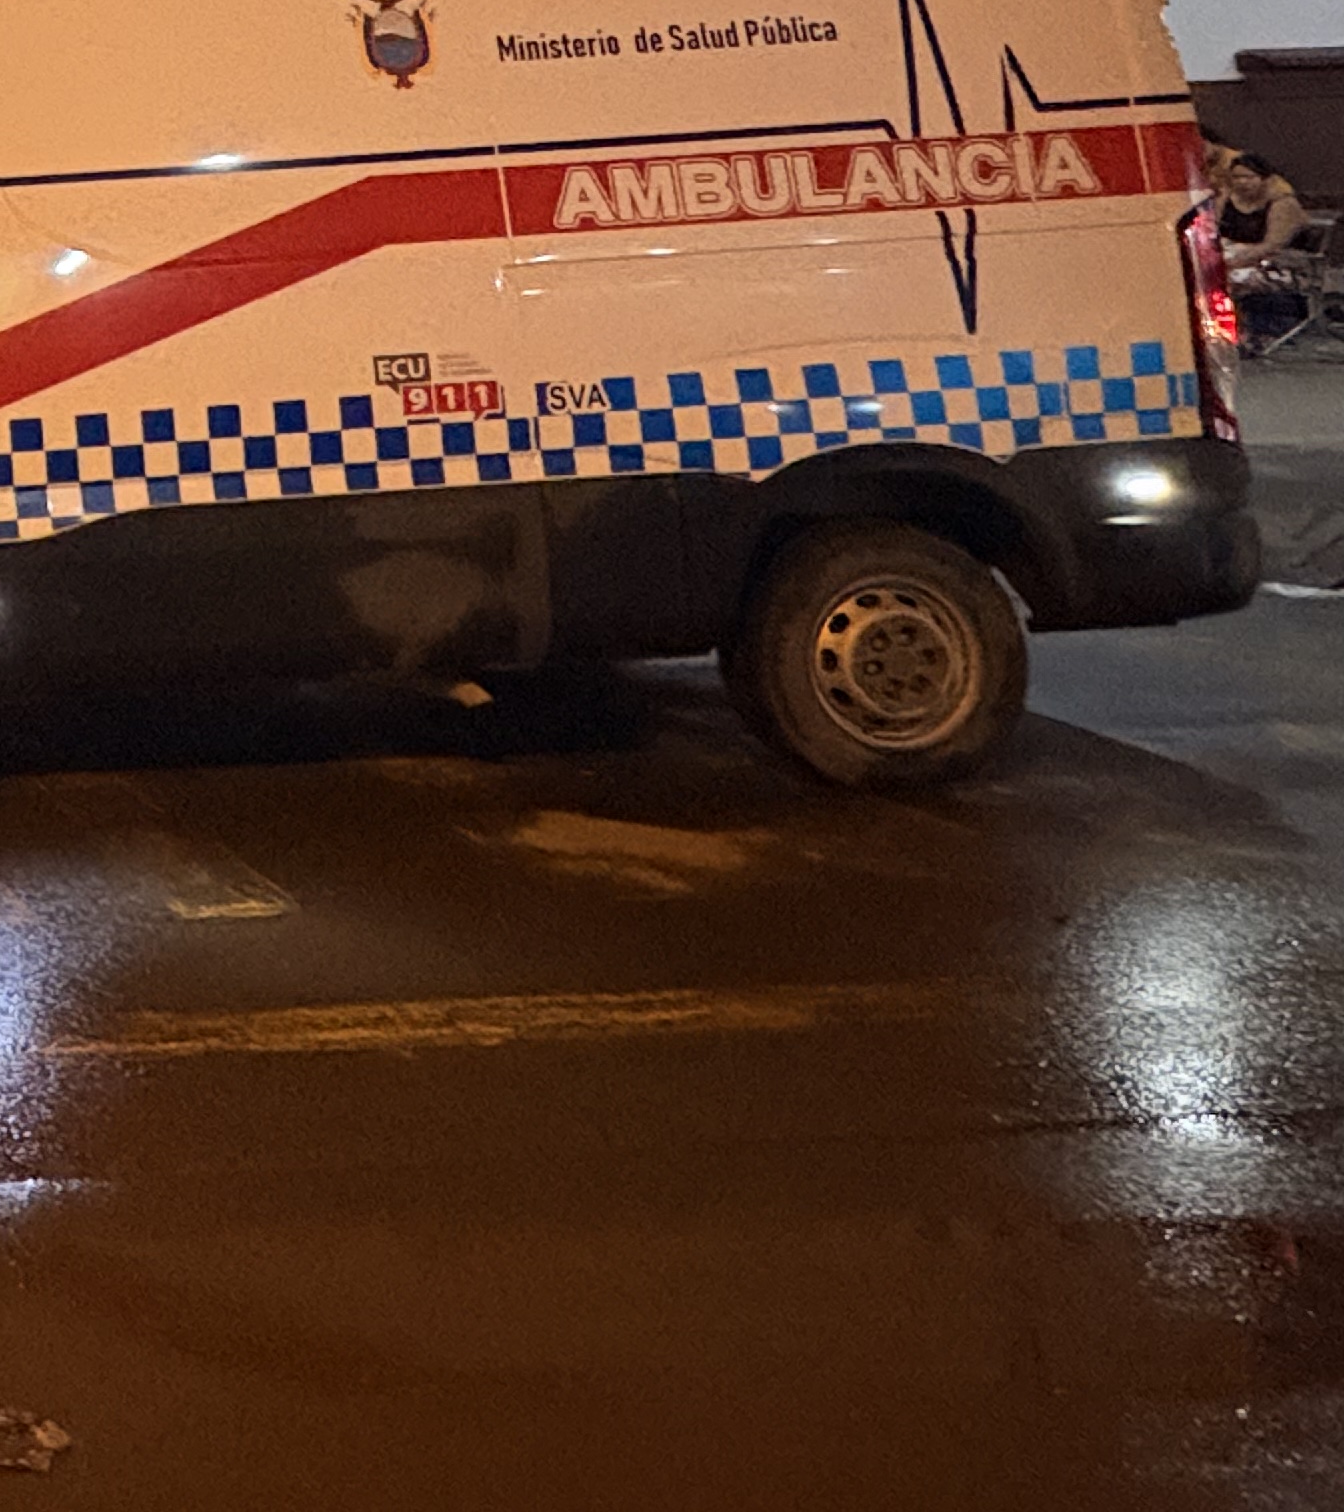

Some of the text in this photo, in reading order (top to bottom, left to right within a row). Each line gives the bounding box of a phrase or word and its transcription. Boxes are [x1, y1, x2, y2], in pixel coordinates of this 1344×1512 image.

[496, 15, 838, 62] Ministerio de Salud Pública
[554, 133, 1101, 229] AMBULANCIA
[377, 357, 426, 381] ECU
[408, 384, 491, 413] 911
[549, 382, 608, 411] SVA
